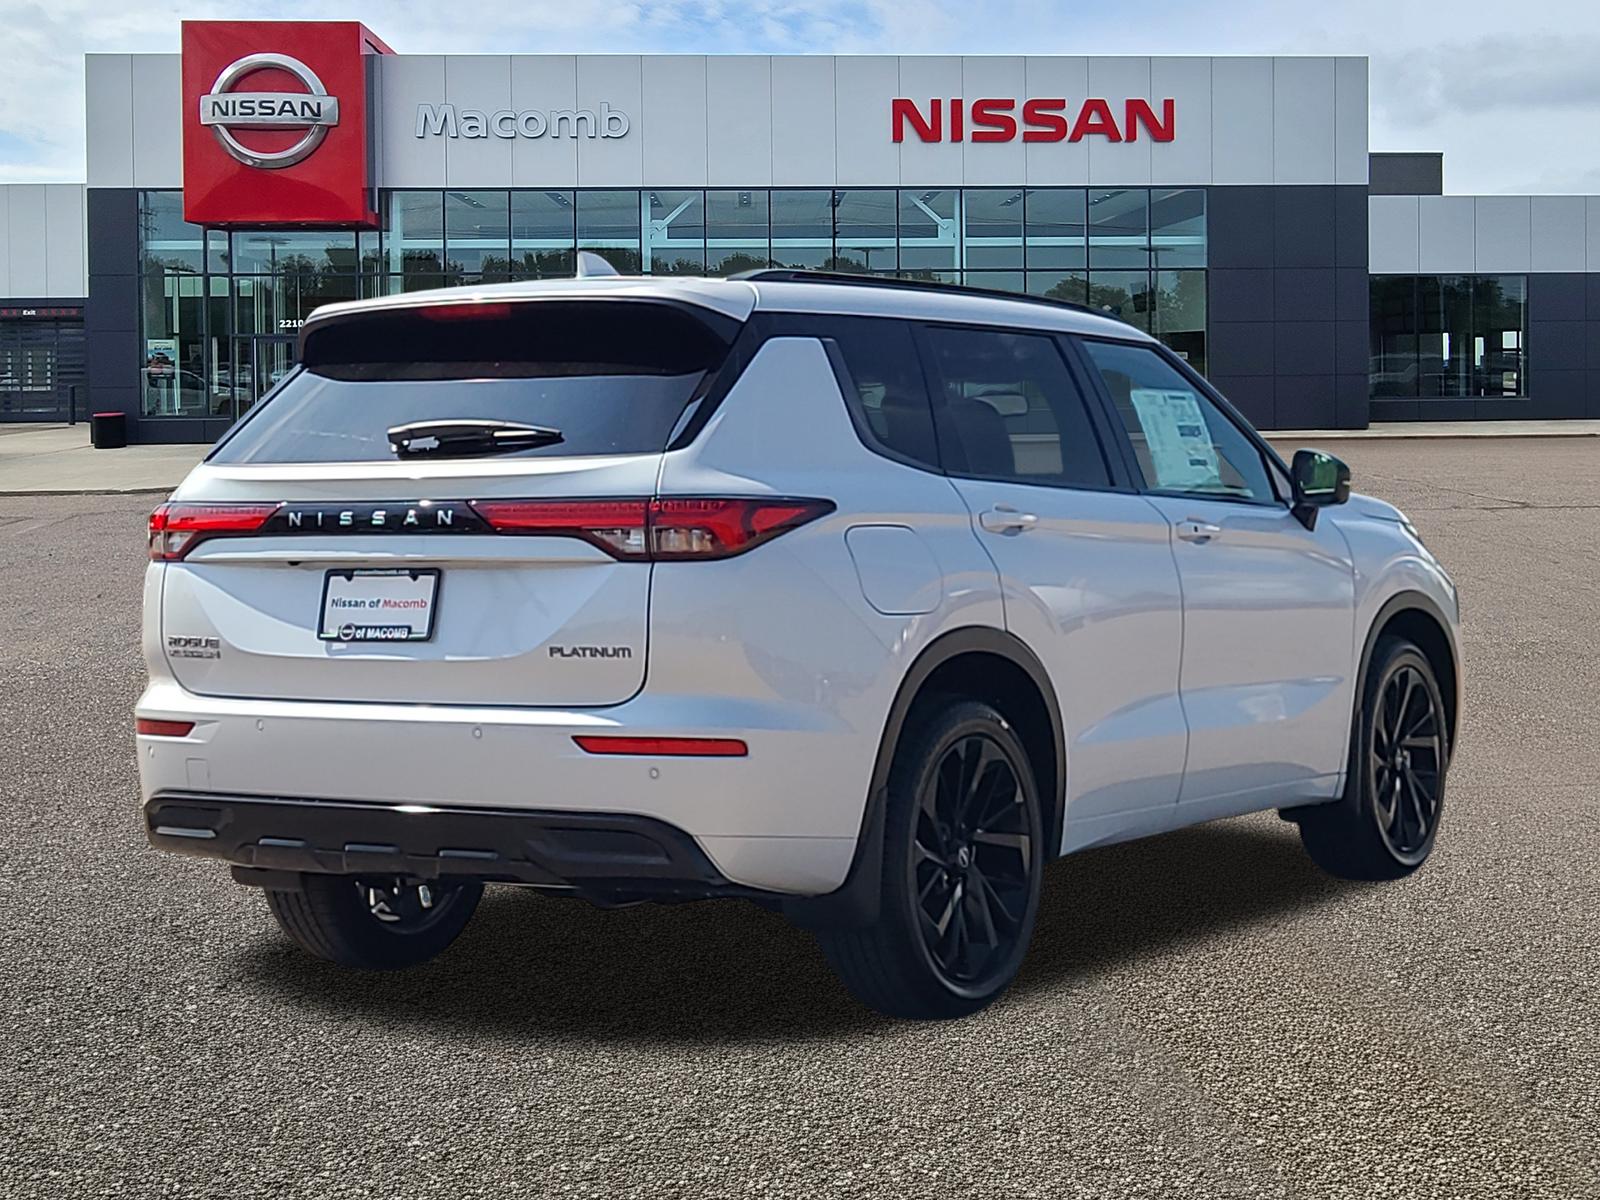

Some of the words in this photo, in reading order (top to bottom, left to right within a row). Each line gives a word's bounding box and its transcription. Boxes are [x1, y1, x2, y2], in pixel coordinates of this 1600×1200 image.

[211, 100, 322, 118] NISSAN
[415, 102, 630, 139] Macomb
[892, 98, 1175, 143] NISSAN
[288, 509, 454, 528] NISSAN
[331, 597, 366, 609] Nissan
[368, 598, 381, 609] of
[382, 598, 428, 609] Macomb
[355, 627, 366, 639] of
[366, 627, 409, 639] MACOMB
[168, 636, 220, 649] ROGUE
[548, 646, 632, 659] PLATINUM
